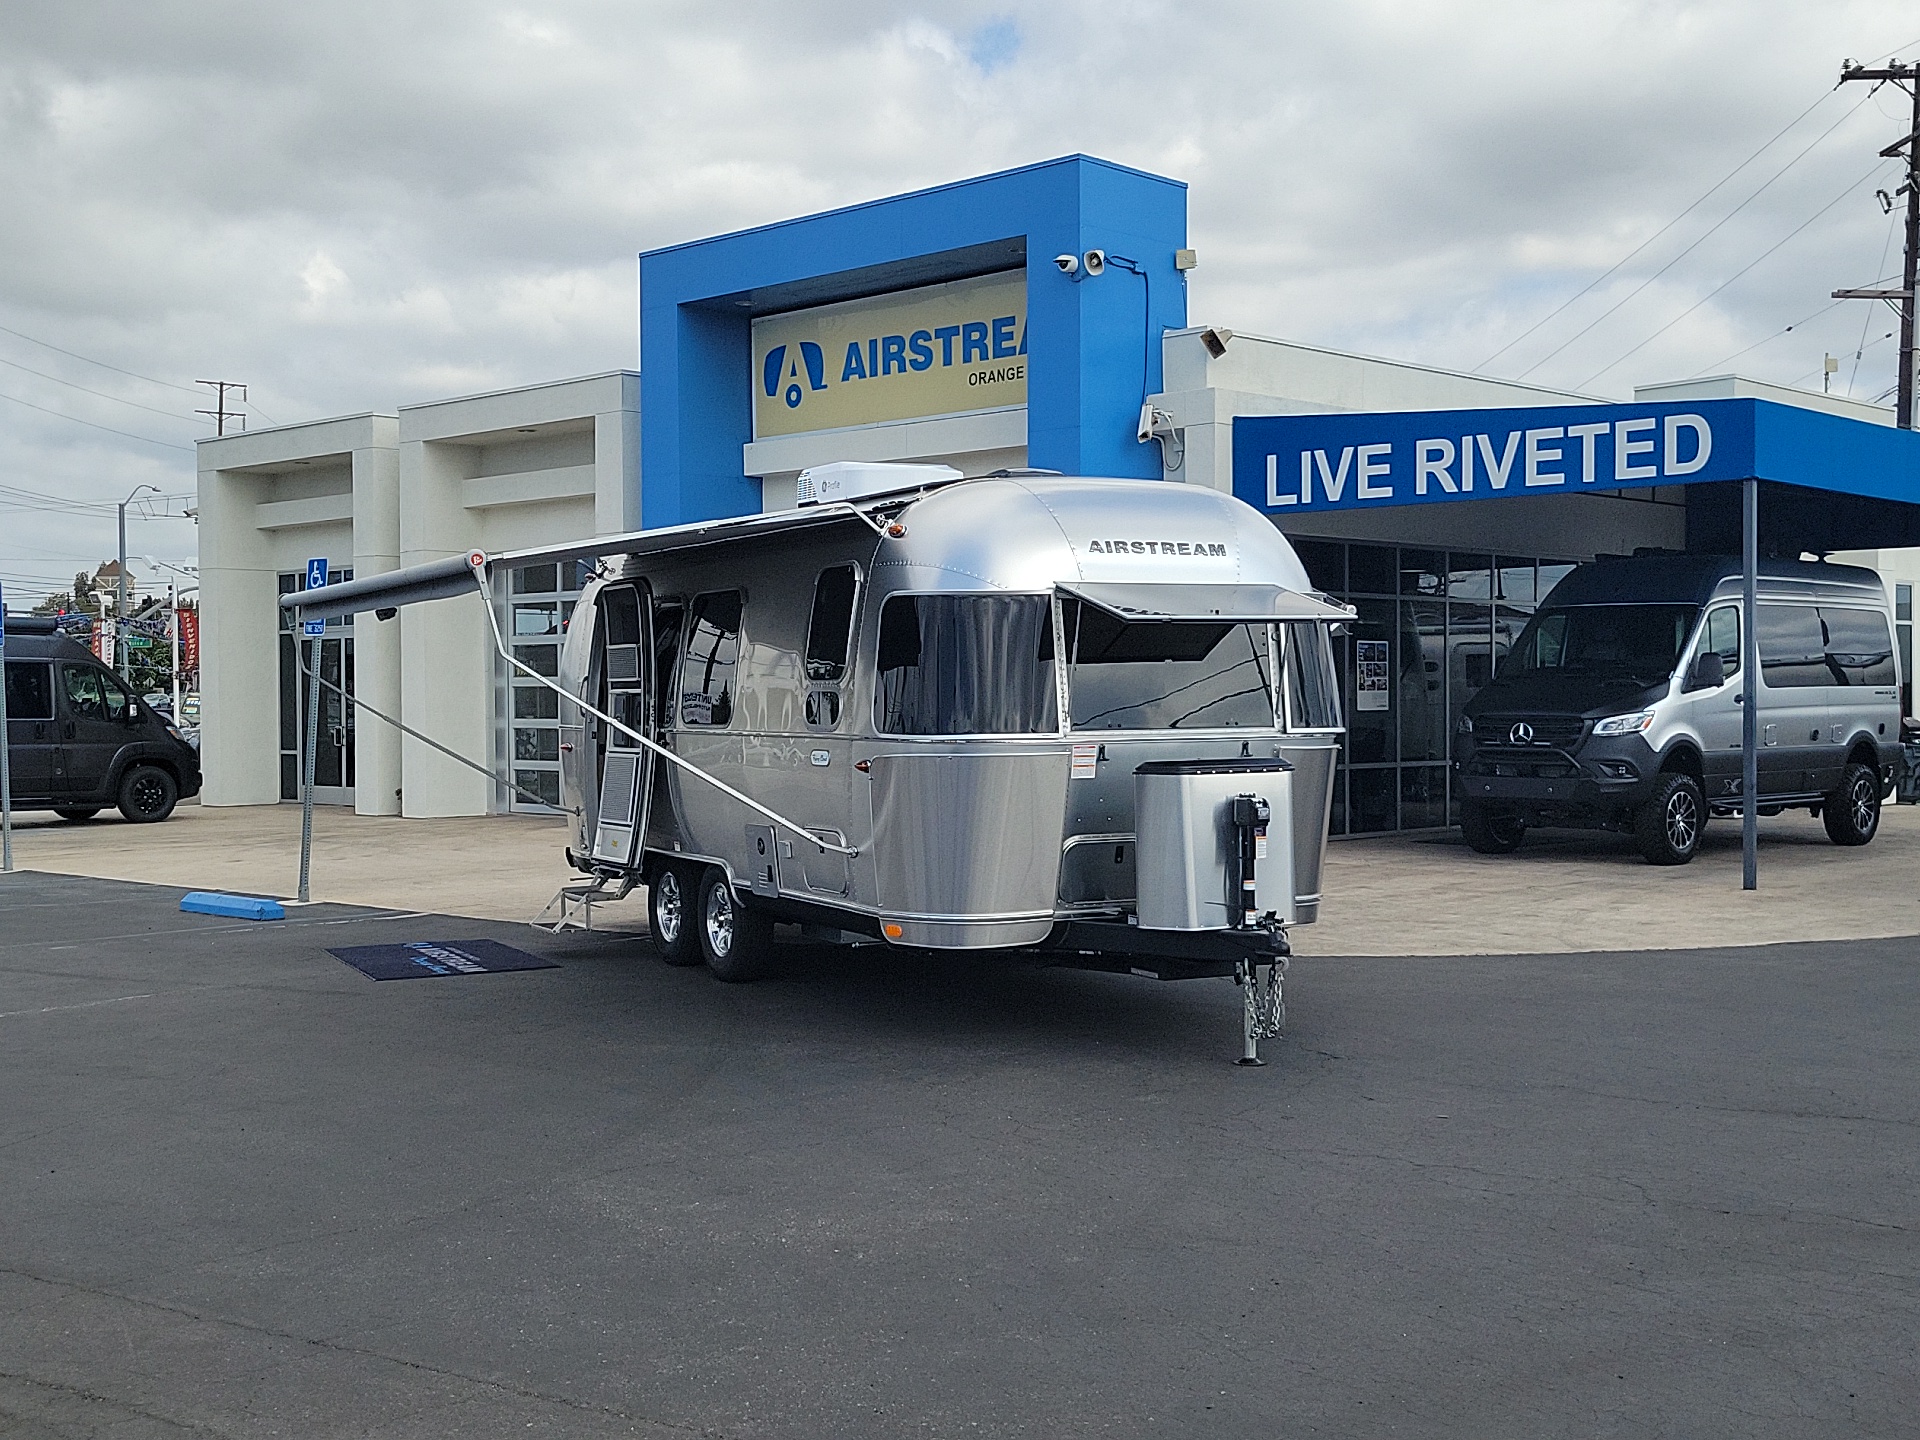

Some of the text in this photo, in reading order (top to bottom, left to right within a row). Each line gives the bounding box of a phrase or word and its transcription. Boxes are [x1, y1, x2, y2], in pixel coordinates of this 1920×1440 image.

[968, 366, 1024, 386] ORANGE
[1266, 414, 1712, 507] LIVE RIVETED
[1088, 540, 1228, 557] AIRSTREAM
